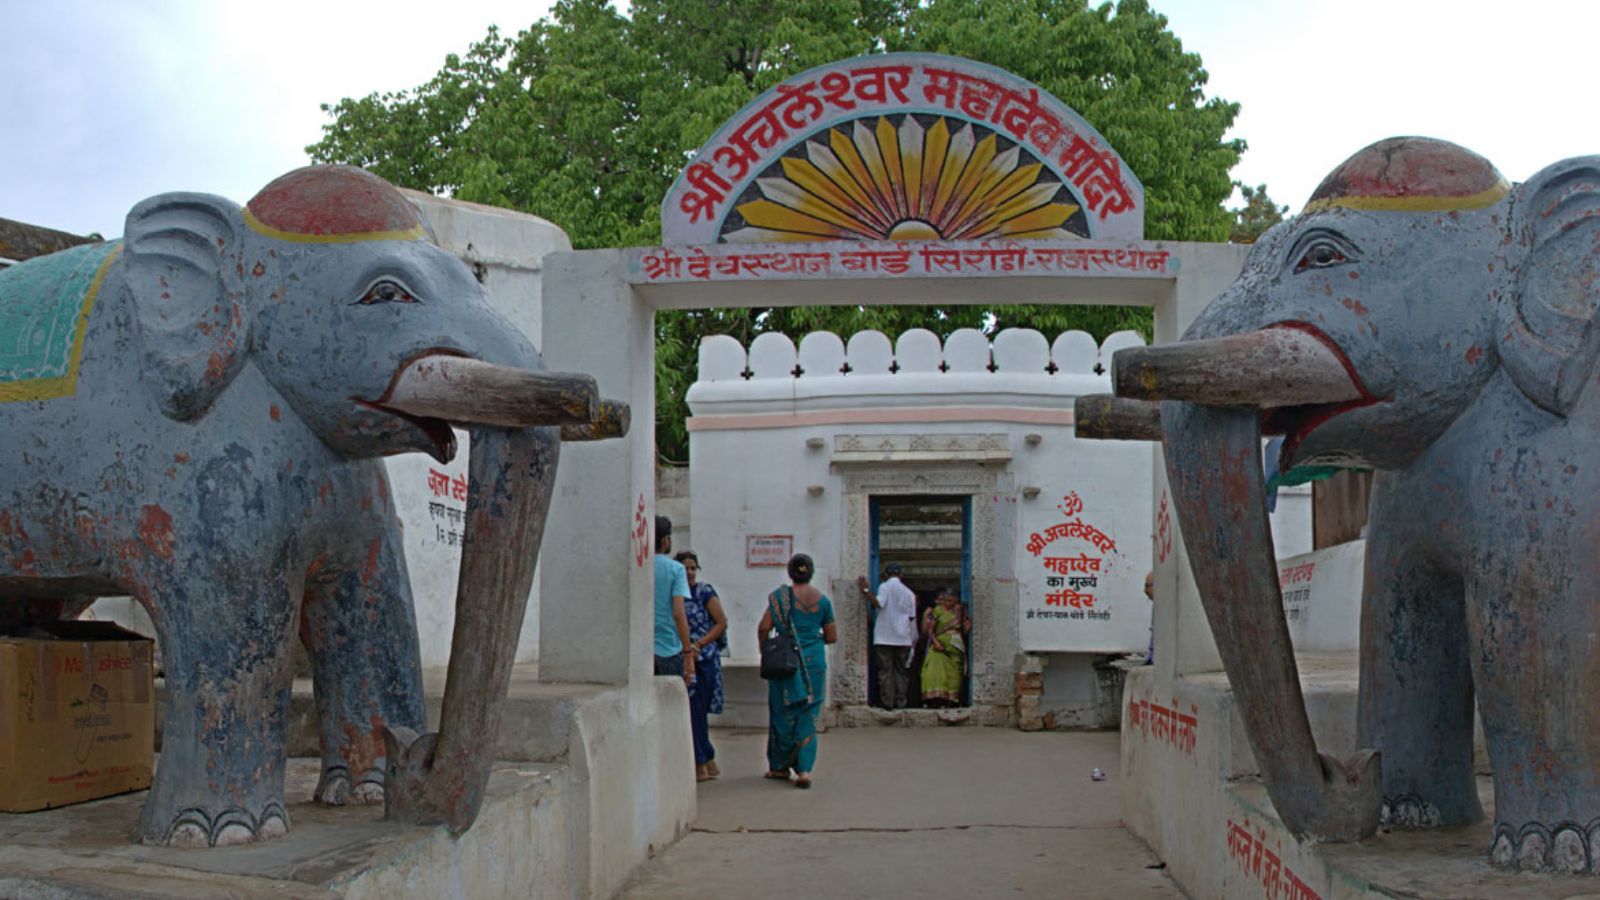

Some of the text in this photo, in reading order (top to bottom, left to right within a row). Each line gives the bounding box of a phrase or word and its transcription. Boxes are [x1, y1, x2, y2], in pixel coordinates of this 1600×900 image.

[679, 65, 1136, 224] श्री अचलेश्वर महादेव मंदिर
[642, 246, 682, 279] श्री
[687, 247, 831, 279] देवस्थान
[840, 242, 912, 275] बोर्ड
[1026, 517, 1116, 557] श्री अचलेश्वर
[1044, 553, 1102, 575] महादेव
[1047, 576, 1064, 588] का
[1045, 589, 1094, 609] मंदिर
